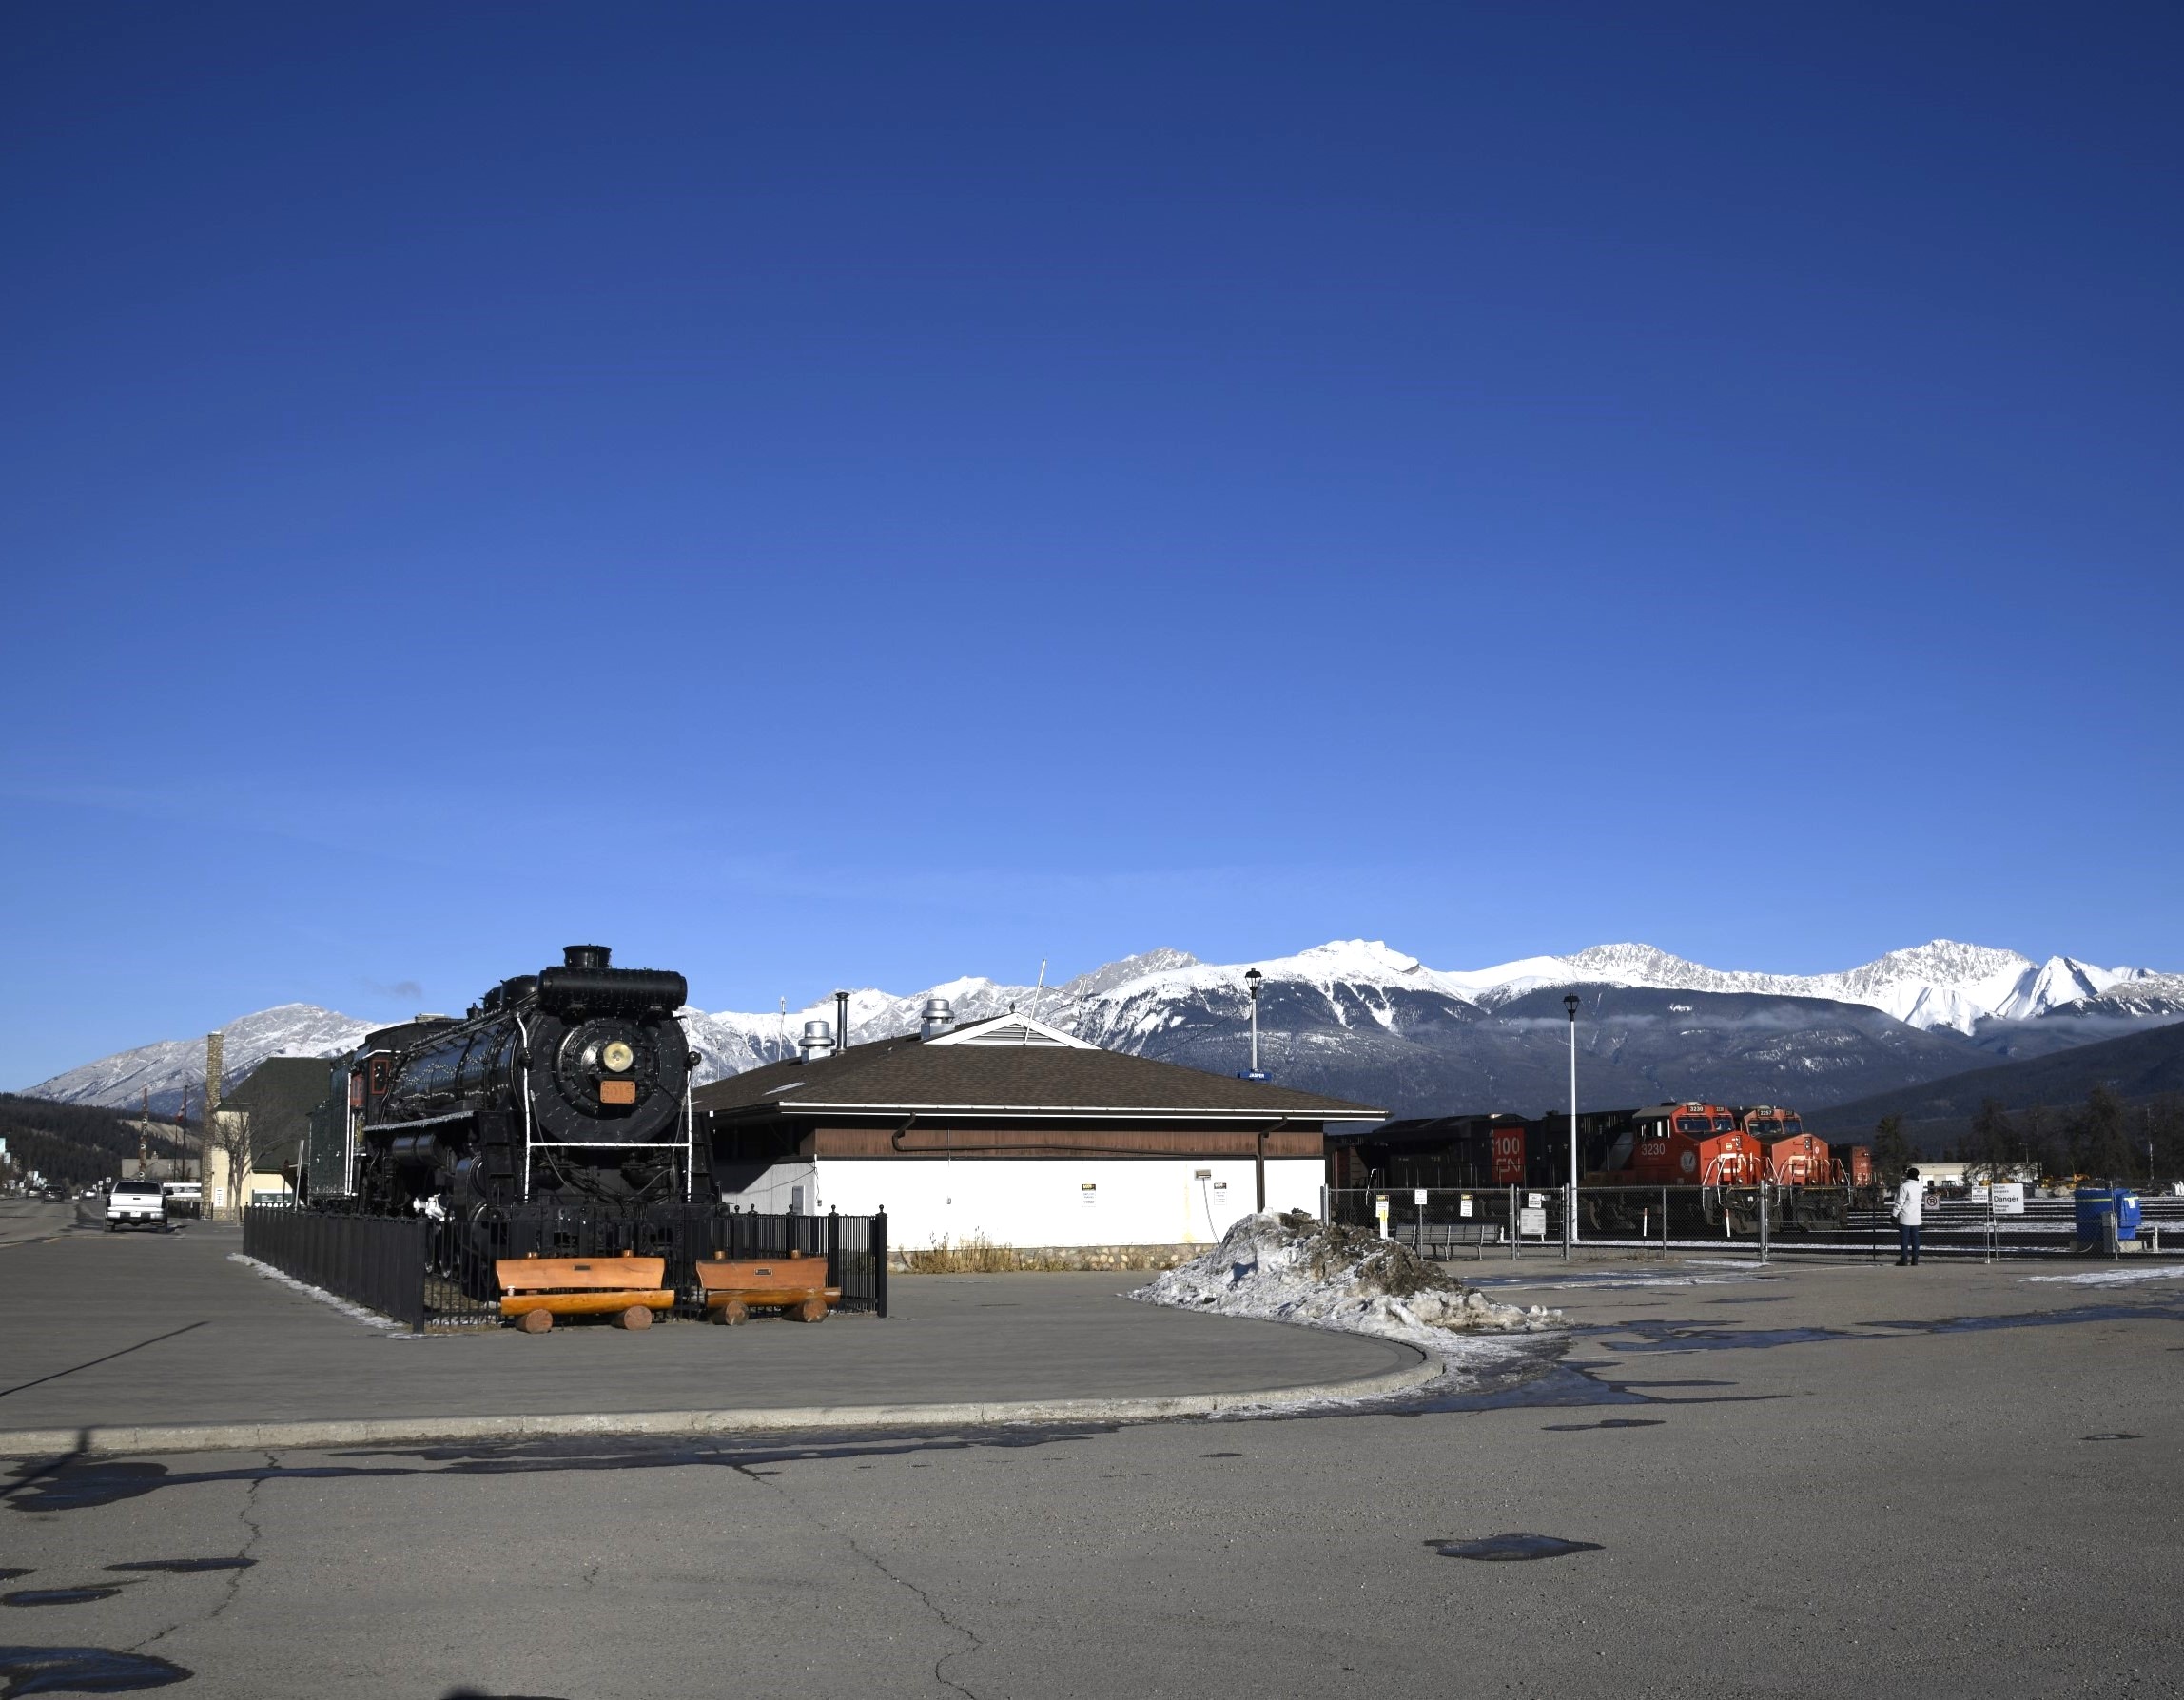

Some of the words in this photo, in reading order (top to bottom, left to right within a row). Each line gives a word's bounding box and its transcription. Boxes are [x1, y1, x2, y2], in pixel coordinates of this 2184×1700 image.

[1641, 1143, 1666, 1156] 3230
[1496, 1158, 1521, 1173] CN
[1718, 1153, 1753, 1174] CN
